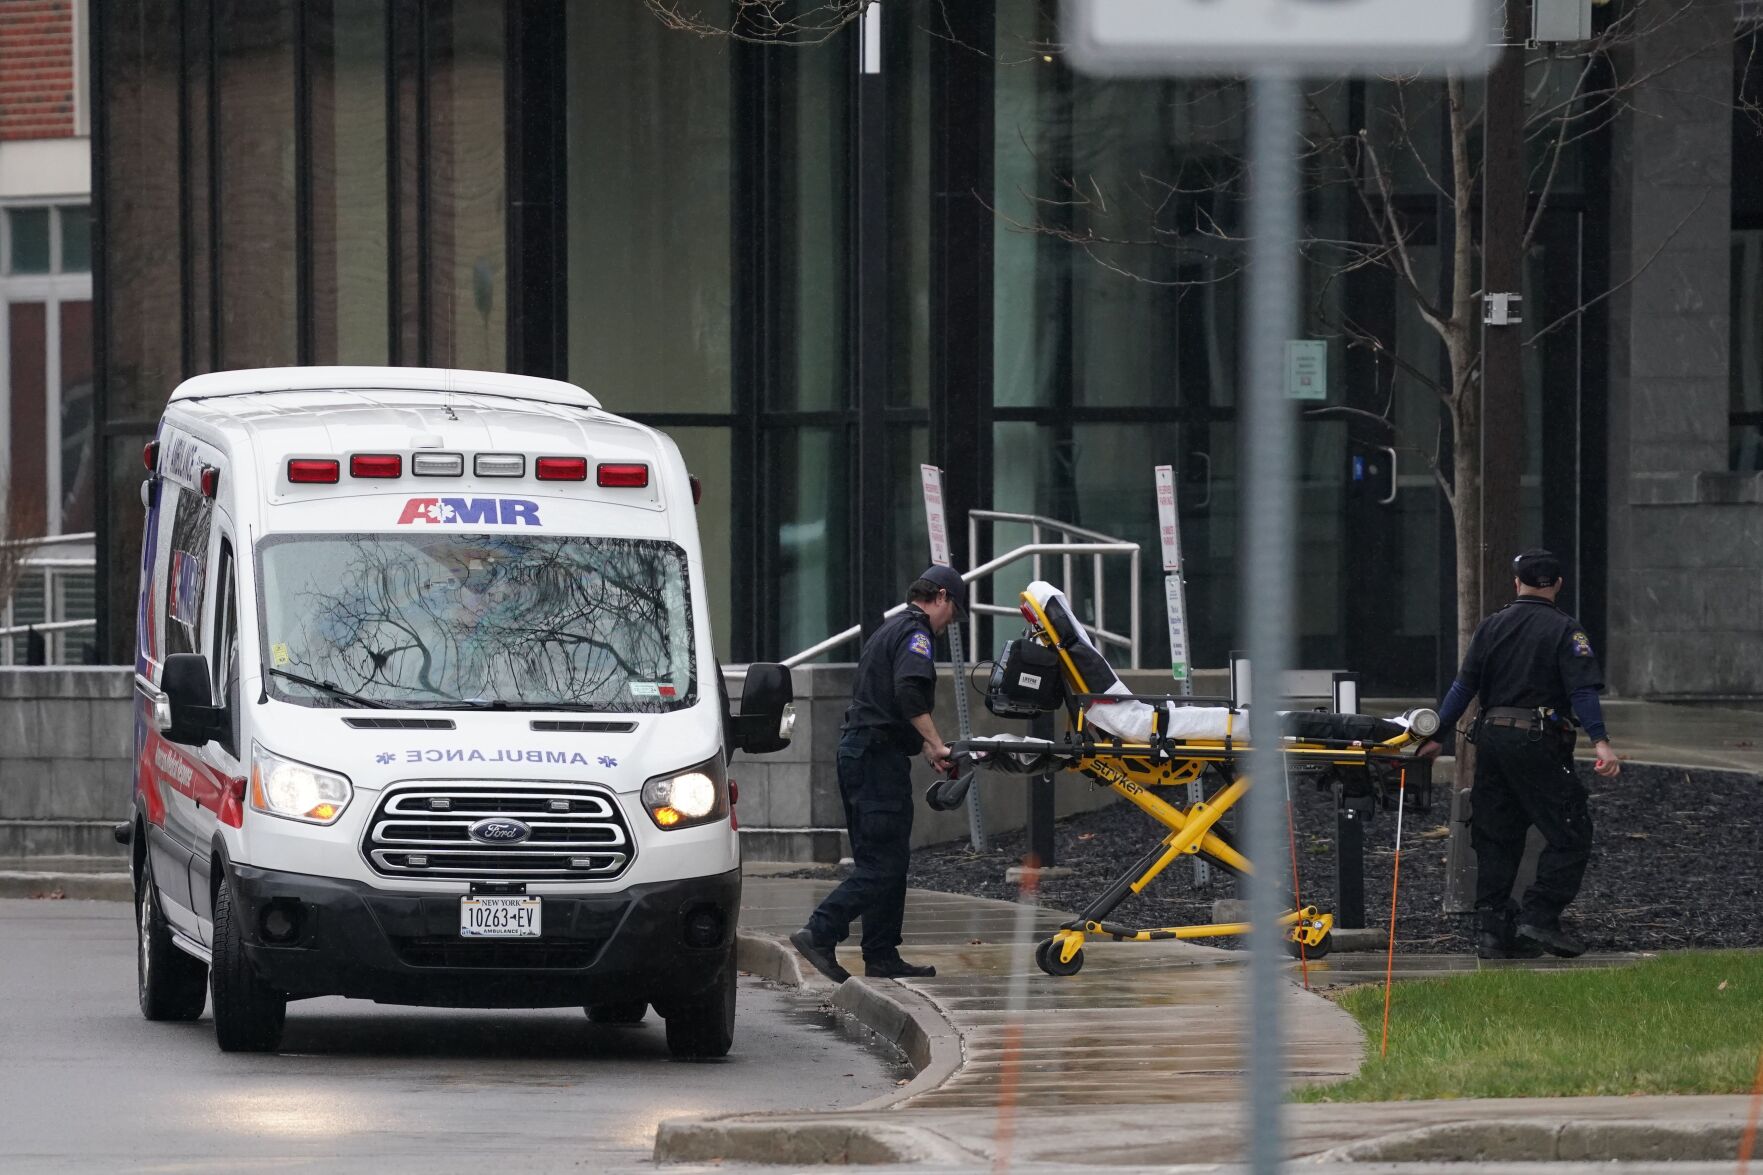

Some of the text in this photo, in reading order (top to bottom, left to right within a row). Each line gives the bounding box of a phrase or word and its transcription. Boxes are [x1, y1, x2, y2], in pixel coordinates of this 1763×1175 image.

[397, 497, 543, 526] AMR
[1090, 760, 1144, 795] stryker
[484, 823, 517, 838] Ford
[481, 899, 521, 907] NEW YORK
